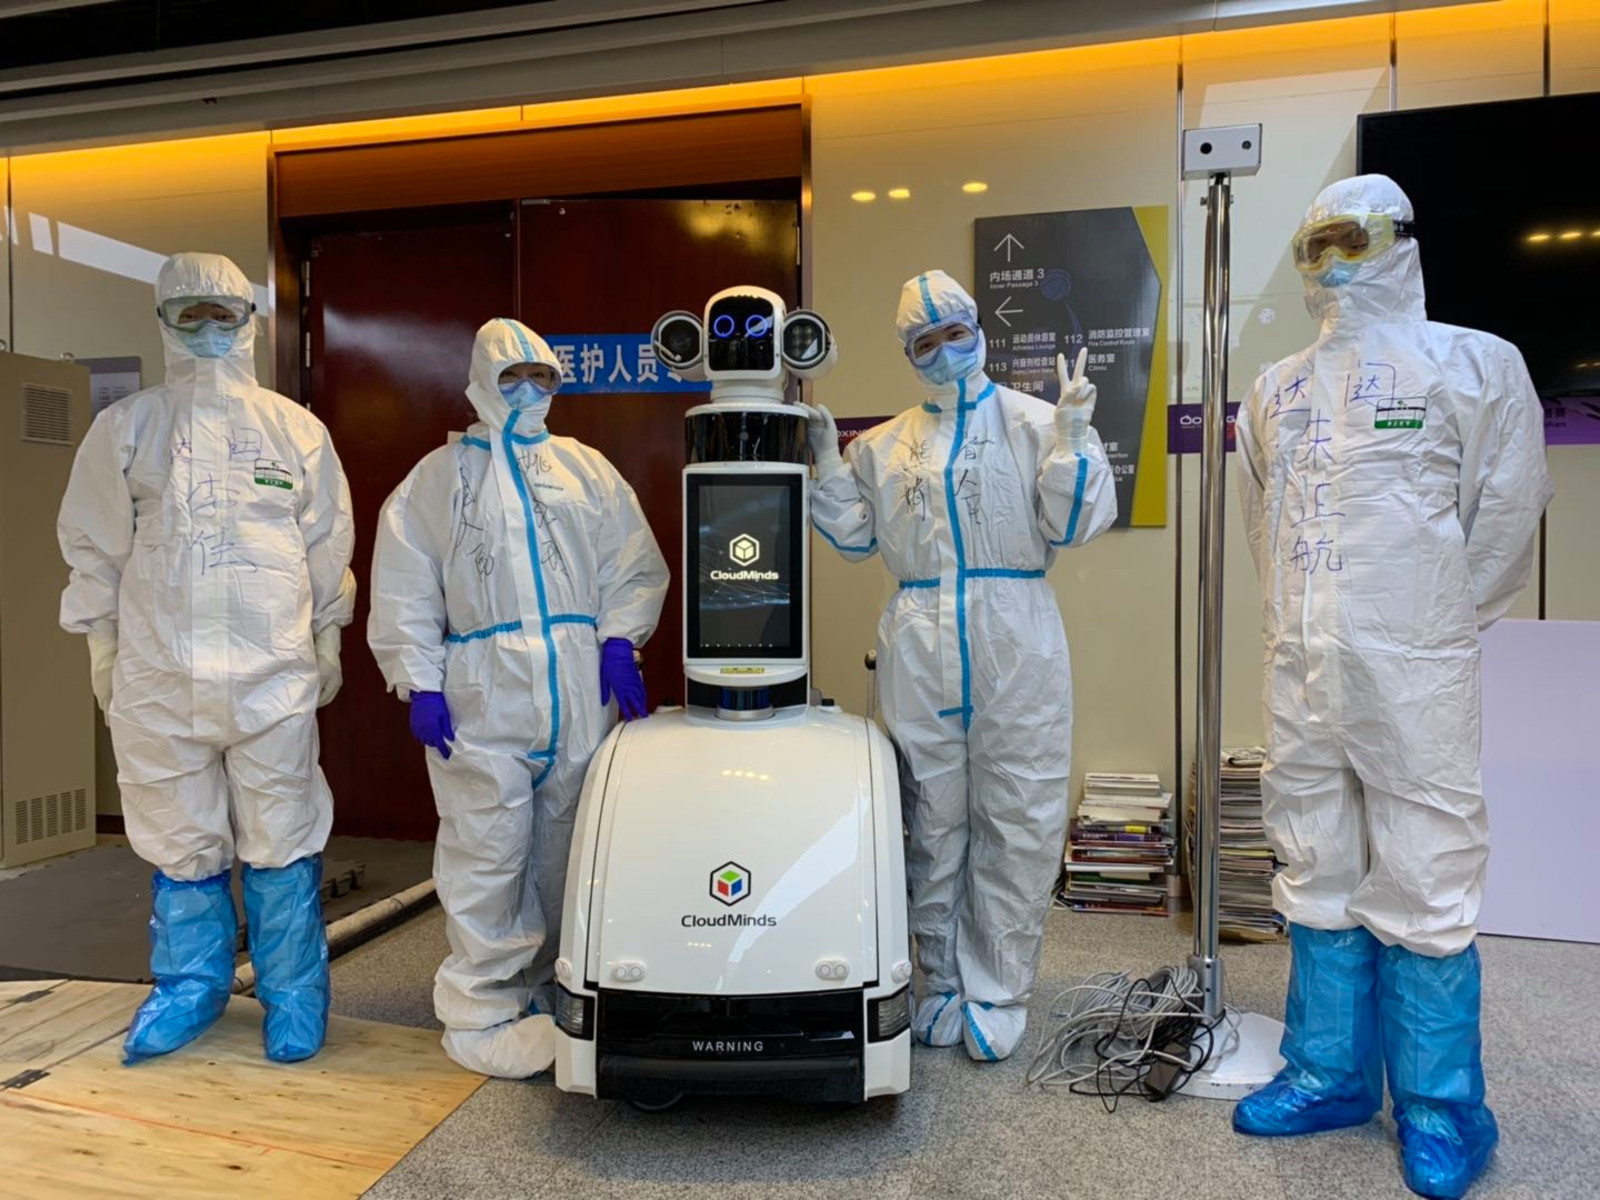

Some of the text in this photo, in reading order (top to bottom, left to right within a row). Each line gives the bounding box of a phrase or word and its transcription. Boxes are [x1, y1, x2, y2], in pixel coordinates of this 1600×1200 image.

[990, 268, 1045, 282] 内场通道 3
[989, 339, 1006, 348] 111
[1064, 334, 1083, 344] 112
[553, 342, 682, 383] 医护人员
[989, 362, 1007, 372] 113
[1011, 381, 1044, 392] 卫生间
[710, 570, 779, 581] CloudMinds
[681, 914, 778, 928] CloudMinds
[692, 1040, 764, 1052] WARNING
